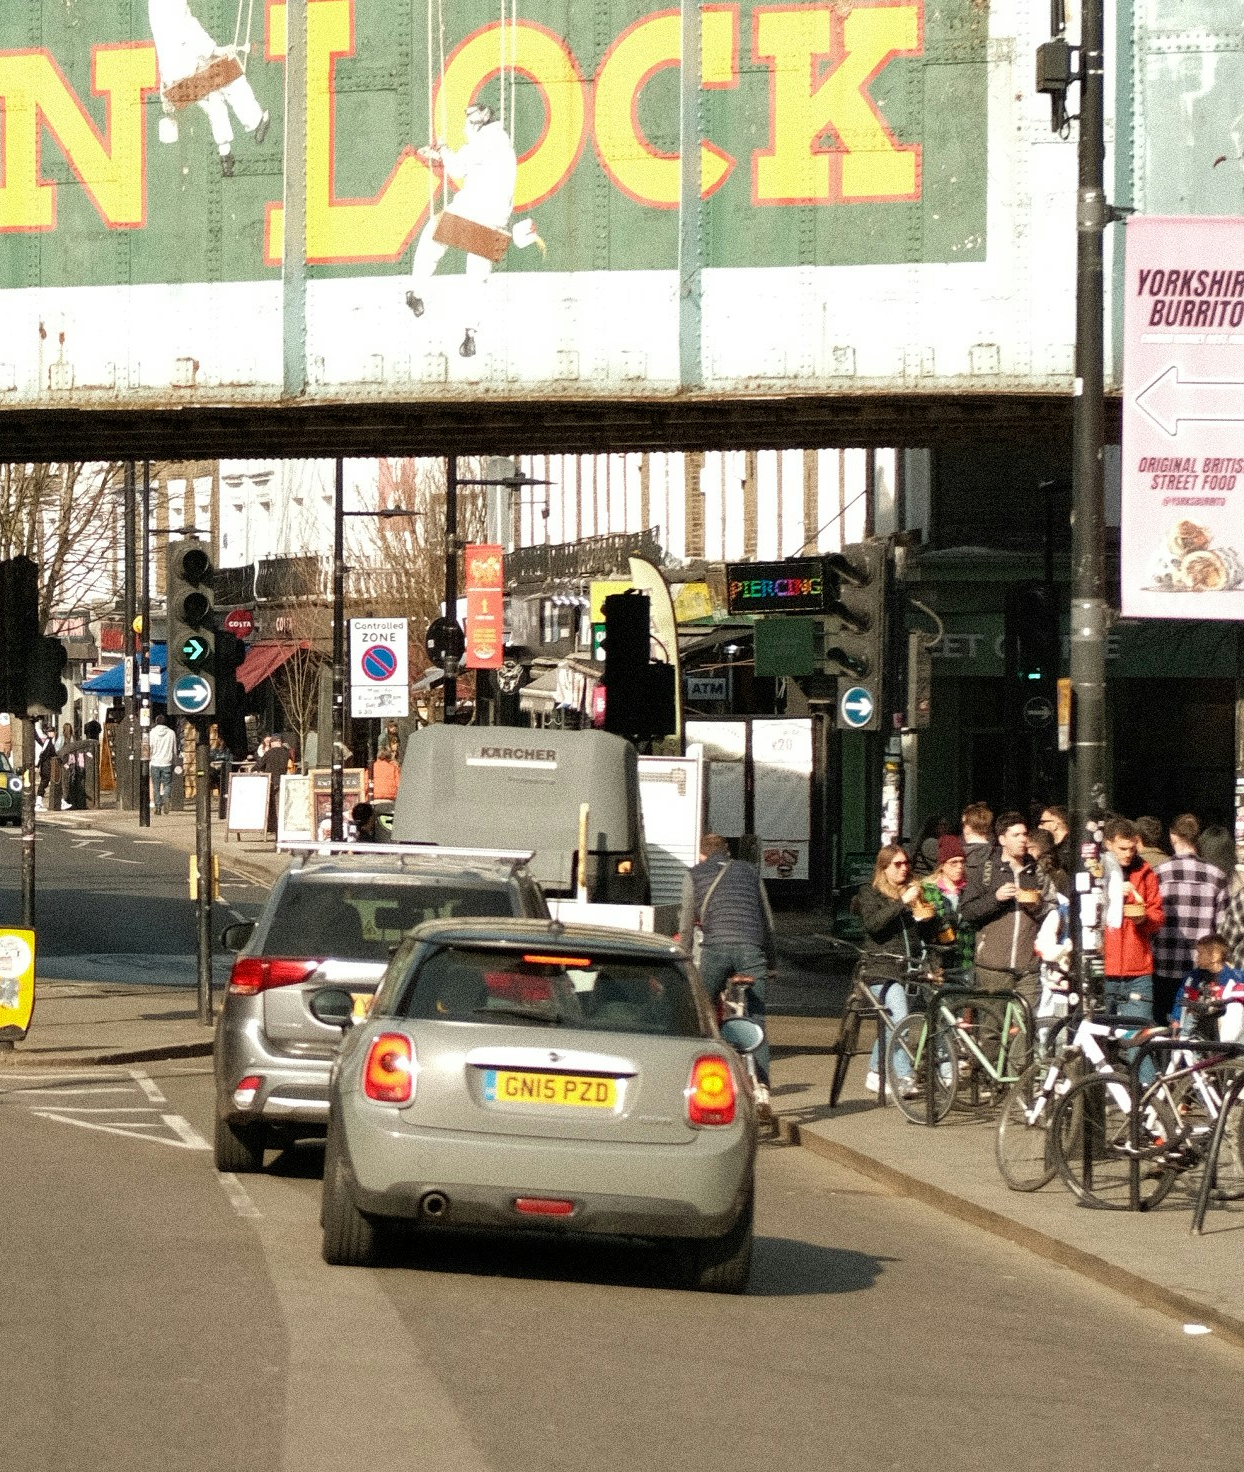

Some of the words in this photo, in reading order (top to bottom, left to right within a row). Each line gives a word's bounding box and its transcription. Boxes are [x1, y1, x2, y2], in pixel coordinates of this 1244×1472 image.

[1138, 457, 1197, 473] ORIGINAL
[1150, 474, 1199, 490] STREET
[1202, 474, 1237, 491] FOOD
[228, 620, 252, 628] COSTA
[354, 621, 404, 630] Controlled
[362, 632, 397, 643] ZONE
[691, 681, 725, 696] ATM
[505, 1076, 556, 1100] GN15
[563, 1080, 609, 1103] PZD
